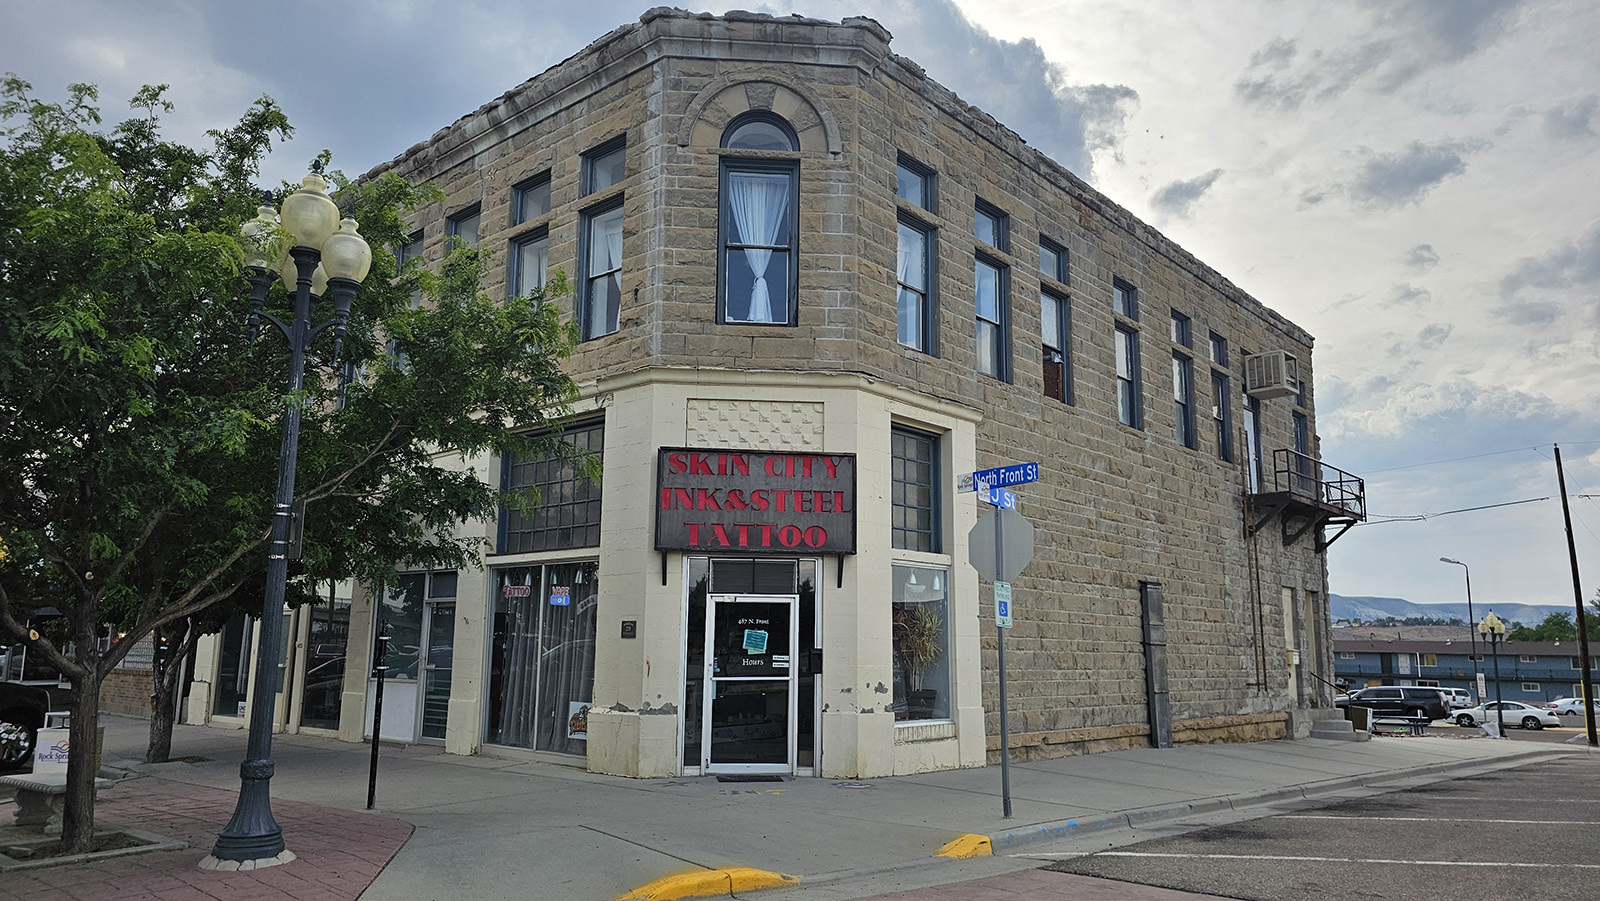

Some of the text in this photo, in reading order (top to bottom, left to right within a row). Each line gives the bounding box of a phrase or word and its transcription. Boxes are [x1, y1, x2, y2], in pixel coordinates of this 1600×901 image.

[668, 453, 843, 478] SKIN CITY
[974, 464, 1037, 489] North Front St
[661, 487, 851, 513] INK&STEEL
[991, 488, 999, 503] J
[1004, 491, 1016, 510] St
[684, 522, 828, 548] TATTOO
[552, 586, 570, 597] VAPE
[38, 751, 68, 762] Rock Spri
